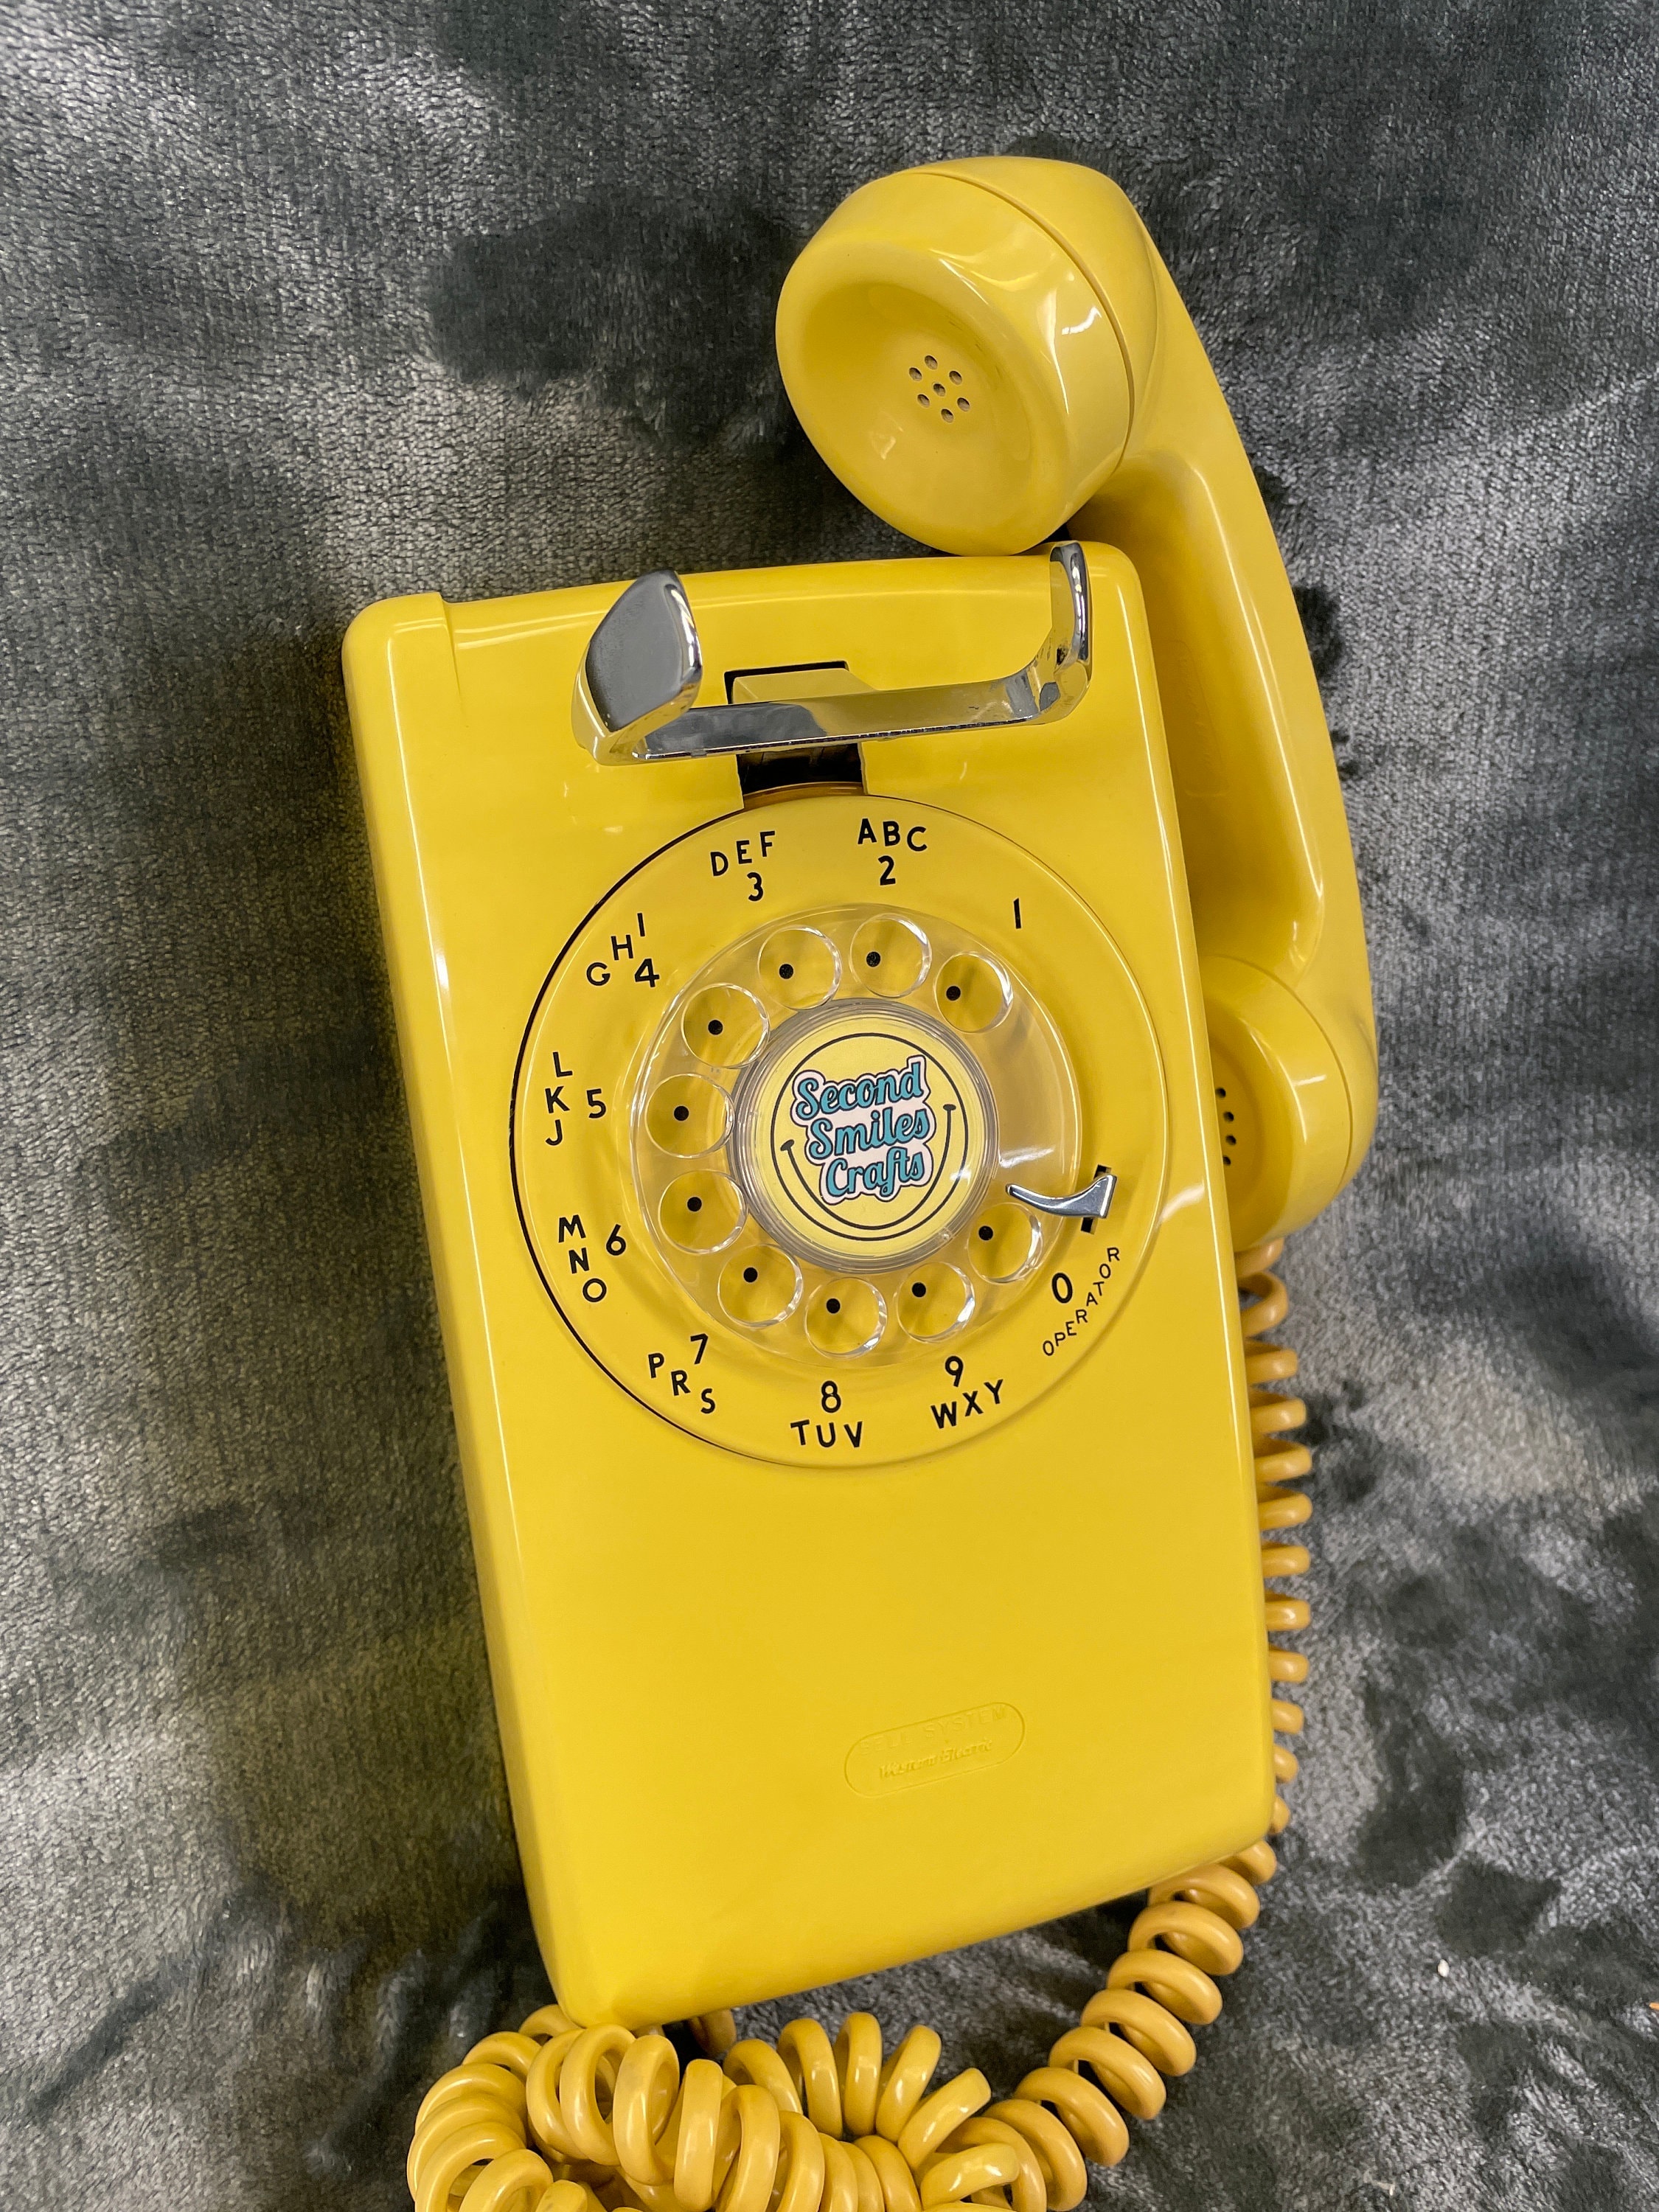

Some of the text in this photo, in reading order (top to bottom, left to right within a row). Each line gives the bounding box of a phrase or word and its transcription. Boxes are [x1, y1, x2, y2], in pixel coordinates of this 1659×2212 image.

[858, 818, 928, 852] ABC
[710, 830, 776, 877] DEF
[746, 872, 764, 902] 3
[877, 855, 896, 886] 2
[1013, 897, 1022, 930] 1
[634, 958, 660, 988] 4
[586, 1088, 607, 1119] 5
[795, 1061, 923, 1121] Second
[808, 1107, 930, 1160] Smiles
[825, 1147, 925, 1197] Crafts
[605, 1223, 627, 1256] 6
[1043, 1247, 1120, 1357] OPERATOR
[1051, 1272, 1074, 1304] 0
[690, 1333, 709, 1365] 7
[647, 1352, 716, 1414] PRS
[945, 1355, 964, 1388] 9
[821, 1380, 841, 1413] 8
[931, 1379, 1004, 1429] WXY
[790, 1419, 863, 1448] TUV
[923, 1706, 1006, 1739] SYSTEM
